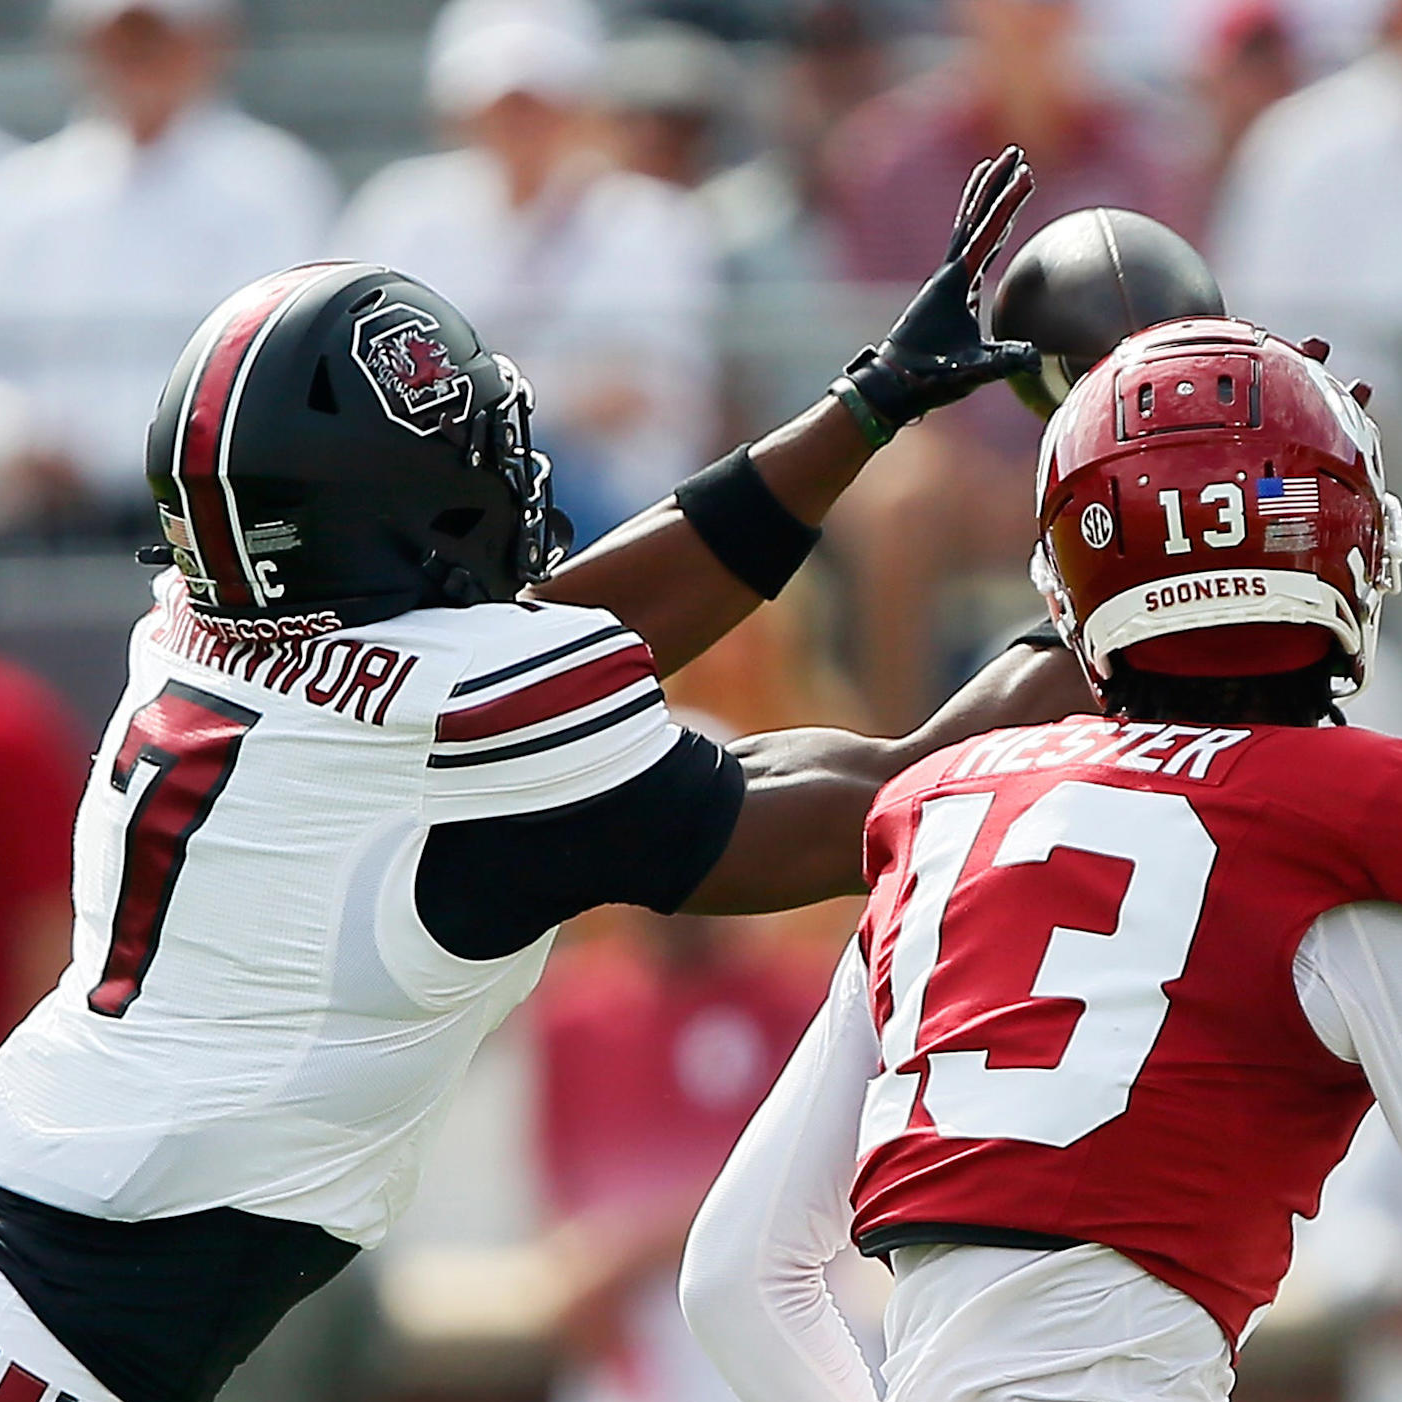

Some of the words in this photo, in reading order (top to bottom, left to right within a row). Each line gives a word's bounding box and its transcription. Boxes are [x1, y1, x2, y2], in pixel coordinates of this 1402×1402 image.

[1082, 504, 1112, 548] SEC
[1158, 482, 1246, 555] 13
[1145, 576, 1267, 612] SOONERS
[953, 721, 1252, 779] HESTER
[88, 679, 262, 1019] 7
[856, 780, 1218, 1161] 13
